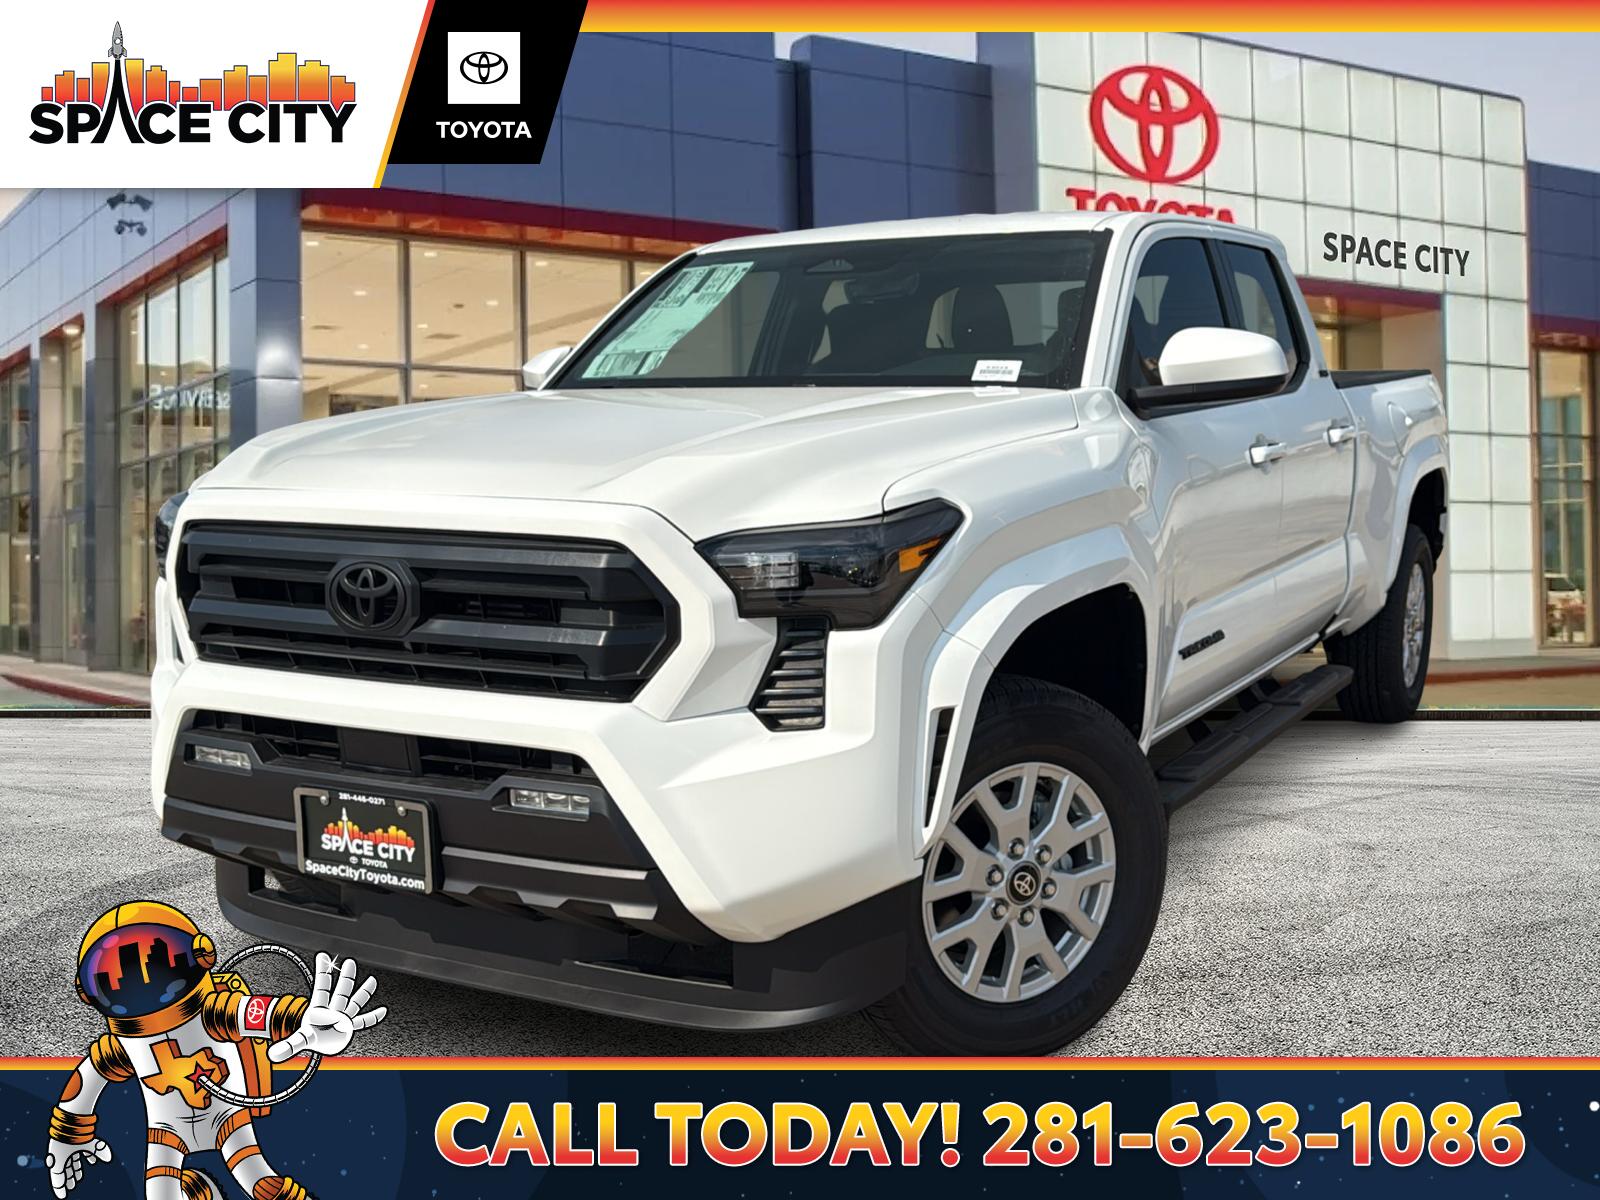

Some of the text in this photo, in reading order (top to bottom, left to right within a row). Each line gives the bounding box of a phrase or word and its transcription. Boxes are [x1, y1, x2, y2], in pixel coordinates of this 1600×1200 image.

[1323, 232, 1470, 277] SPACE CITY
[361, 857, 388, 869] TOYOTA
[377, 841, 416, 863] CITY
[305, 859, 426, 890] SpaceCityToyota.com
